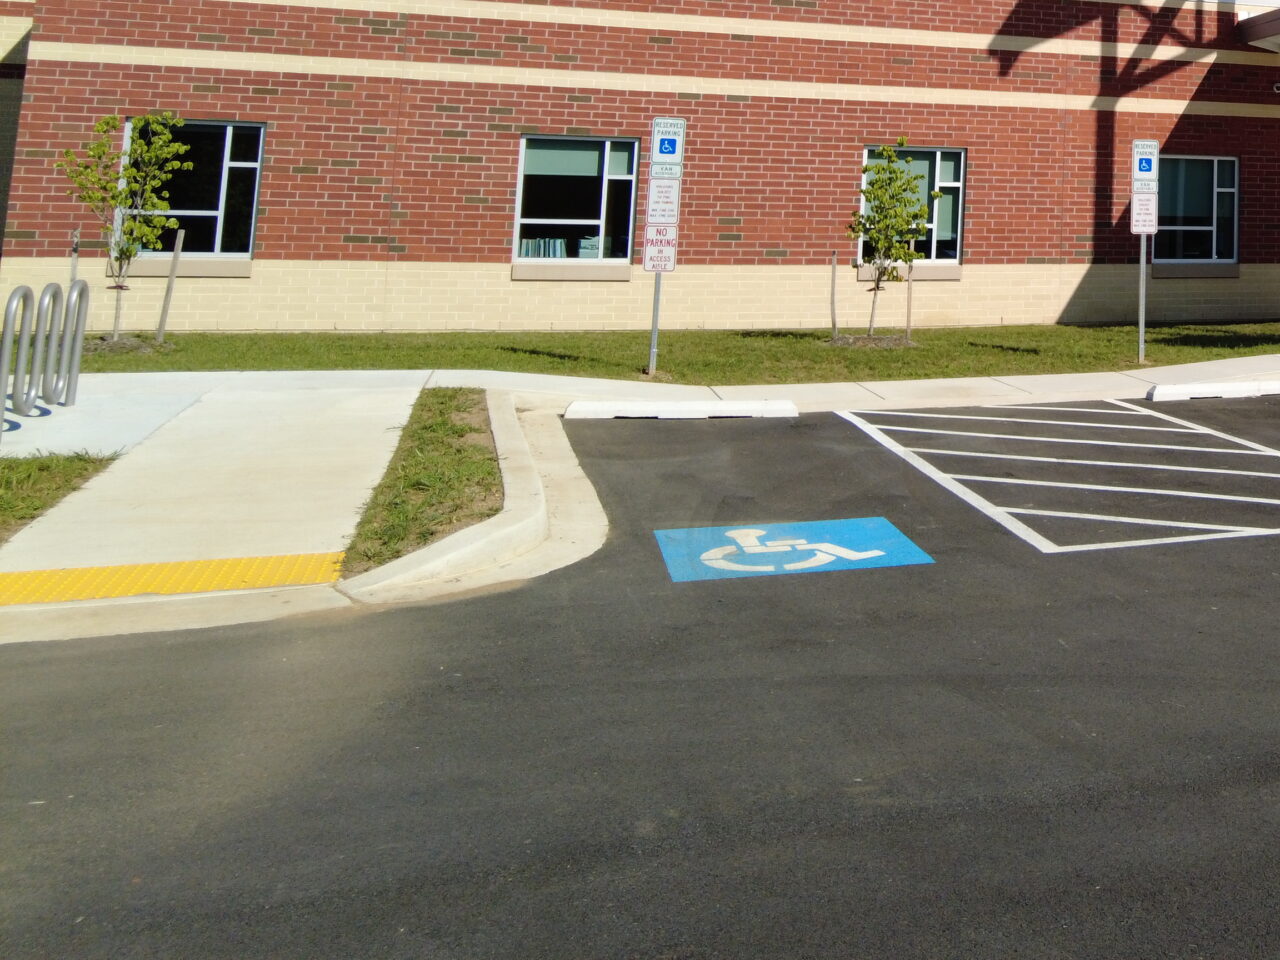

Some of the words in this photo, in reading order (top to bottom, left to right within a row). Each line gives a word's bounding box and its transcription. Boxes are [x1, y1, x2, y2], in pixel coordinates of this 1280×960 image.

[655, 121, 684, 129] RESERVED
[655, 227, 668, 237] NO
[646, 238, 676, 248] PARKING
[649, 255, 671, 263] ACCESS
[651, 262, 668, 270] AISLE
